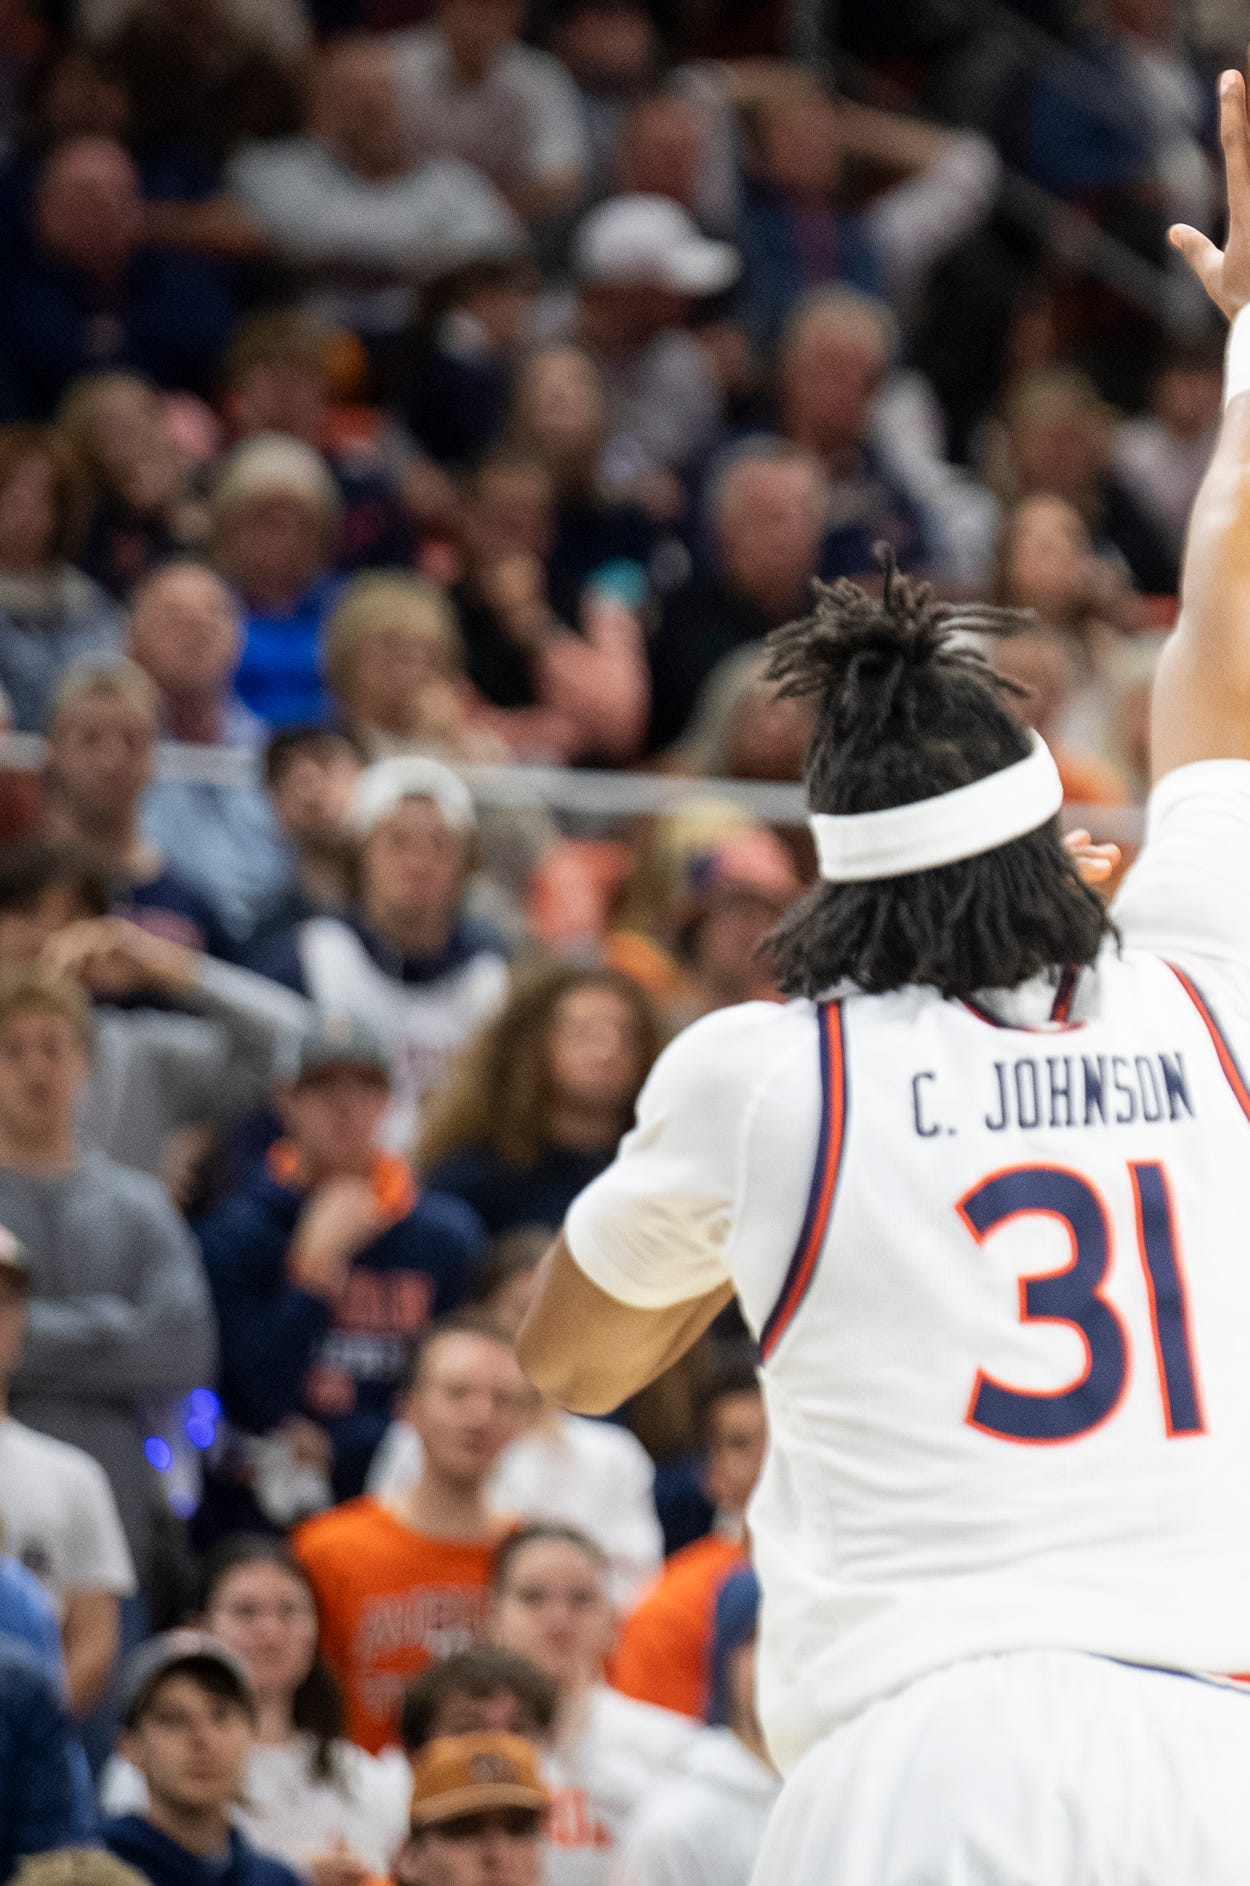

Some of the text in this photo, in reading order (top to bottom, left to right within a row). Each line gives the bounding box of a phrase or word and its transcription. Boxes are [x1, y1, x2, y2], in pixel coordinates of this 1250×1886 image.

[911, 1051, 1198, 1139] C. JOHNSON
[954, 1157, 1209, 1447] 31
